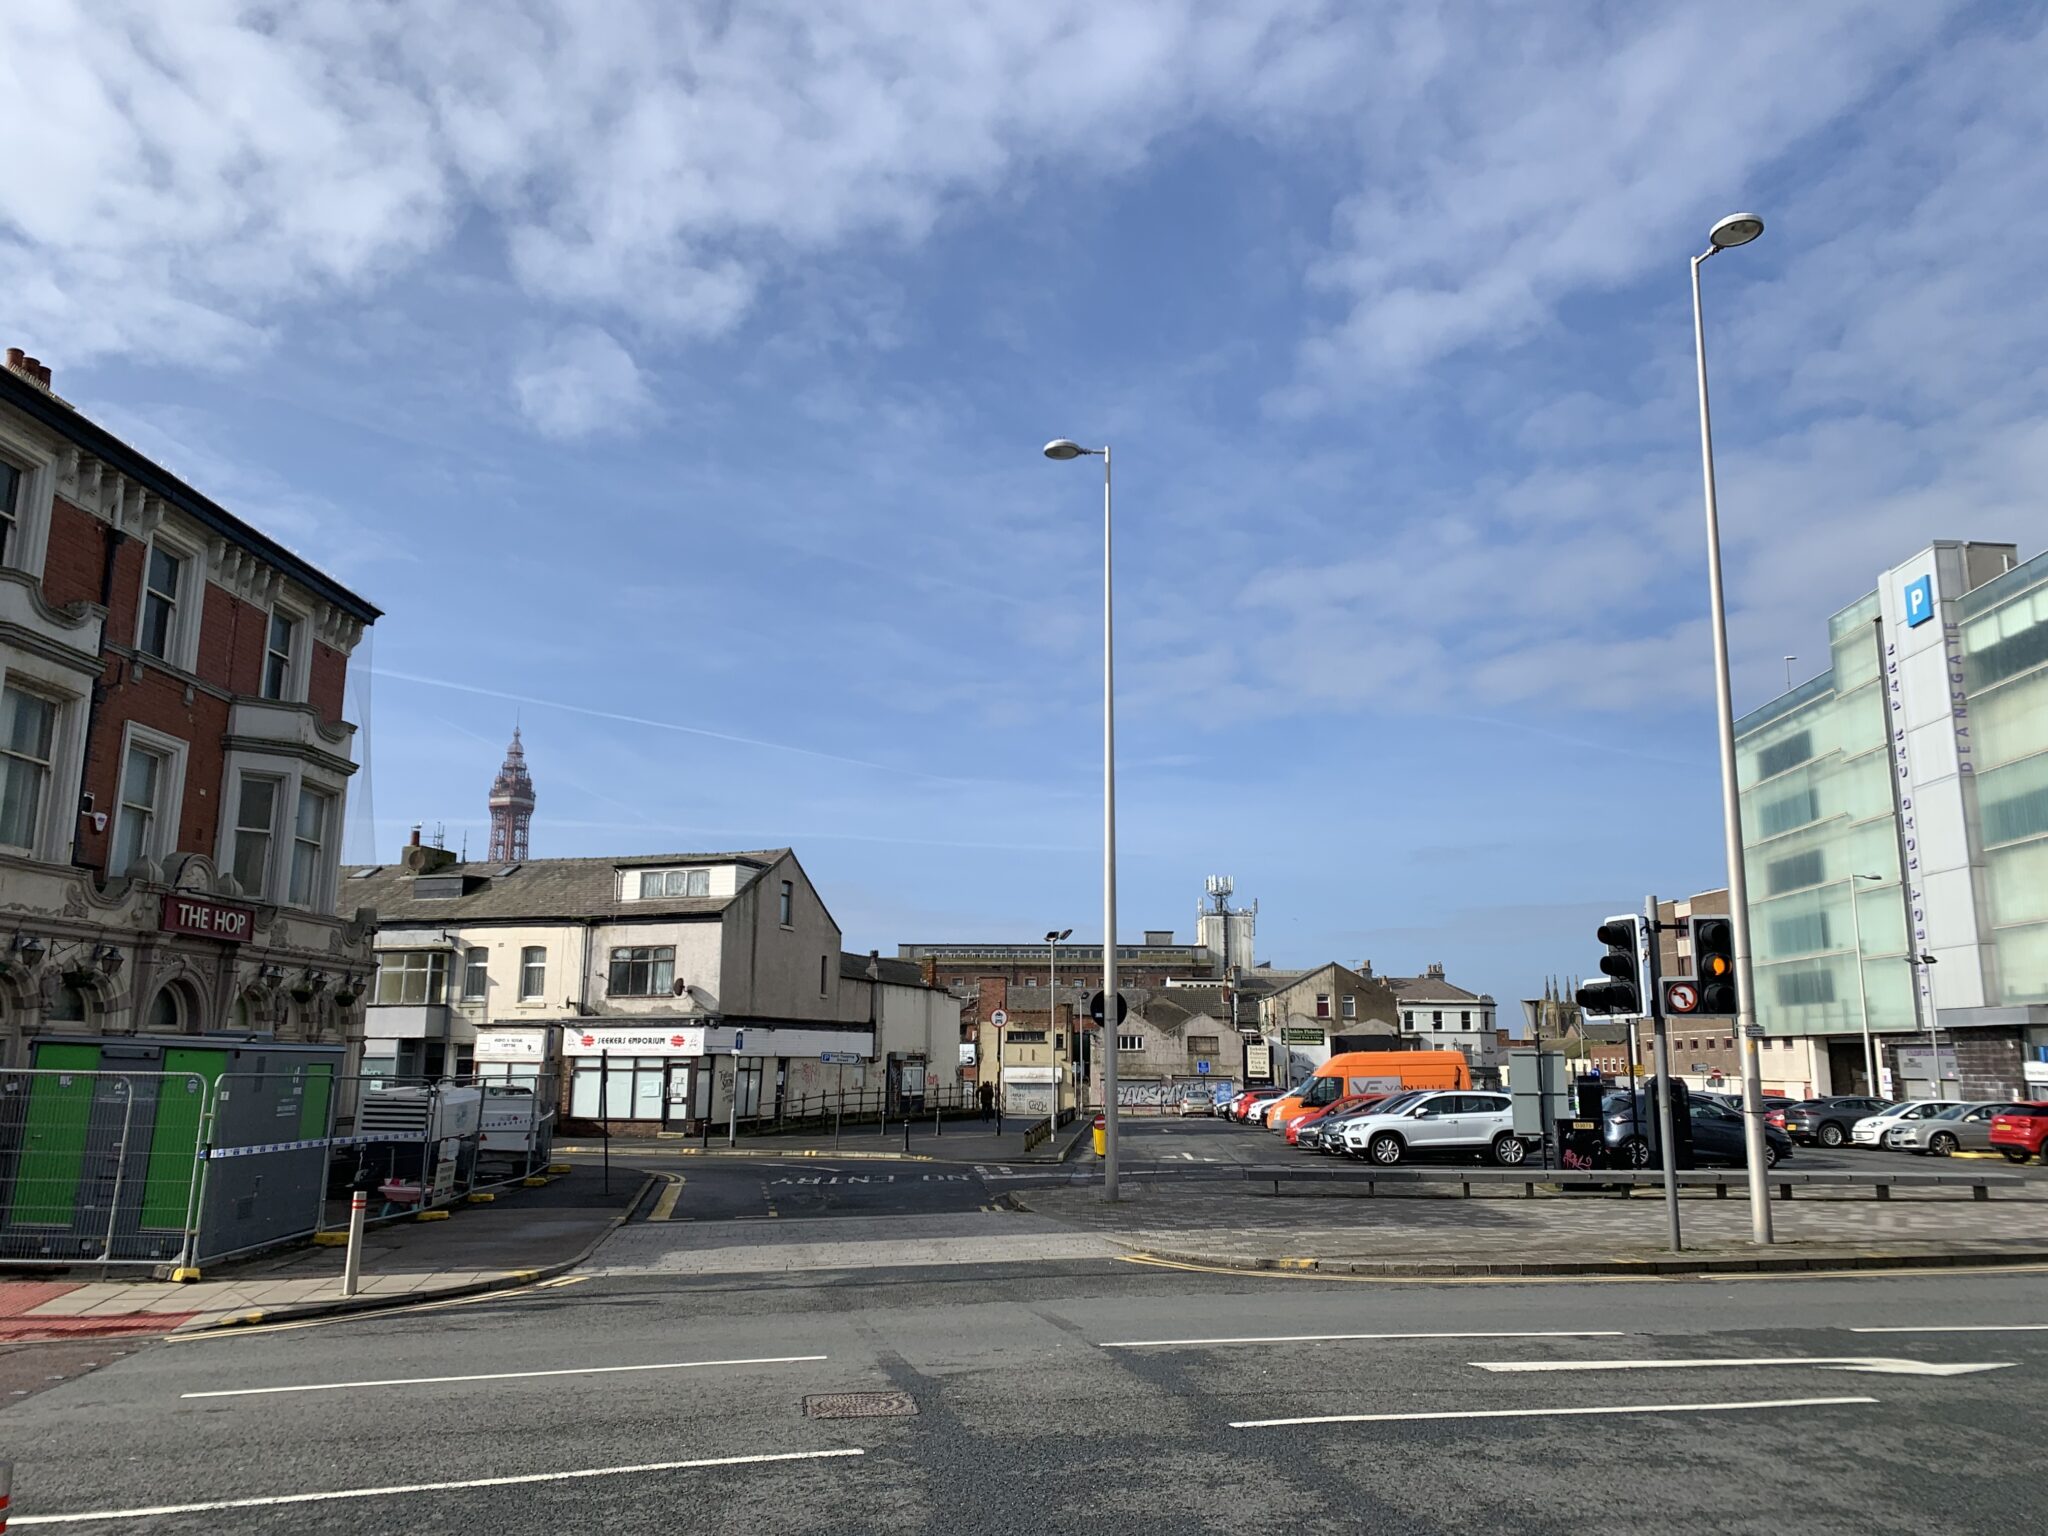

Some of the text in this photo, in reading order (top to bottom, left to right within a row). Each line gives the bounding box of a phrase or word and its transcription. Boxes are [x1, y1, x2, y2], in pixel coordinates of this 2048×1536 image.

[1910, 588, 1924, 615] P
[1886, 643, 1901, 712] PARK
[1944, 621, 1975, 774] DEANSGATE
[1894, 728, 1909, 779] CAR
[1902, 797, 1919, 870] ROAD
[178, 903, 246, 935] THE HOP
